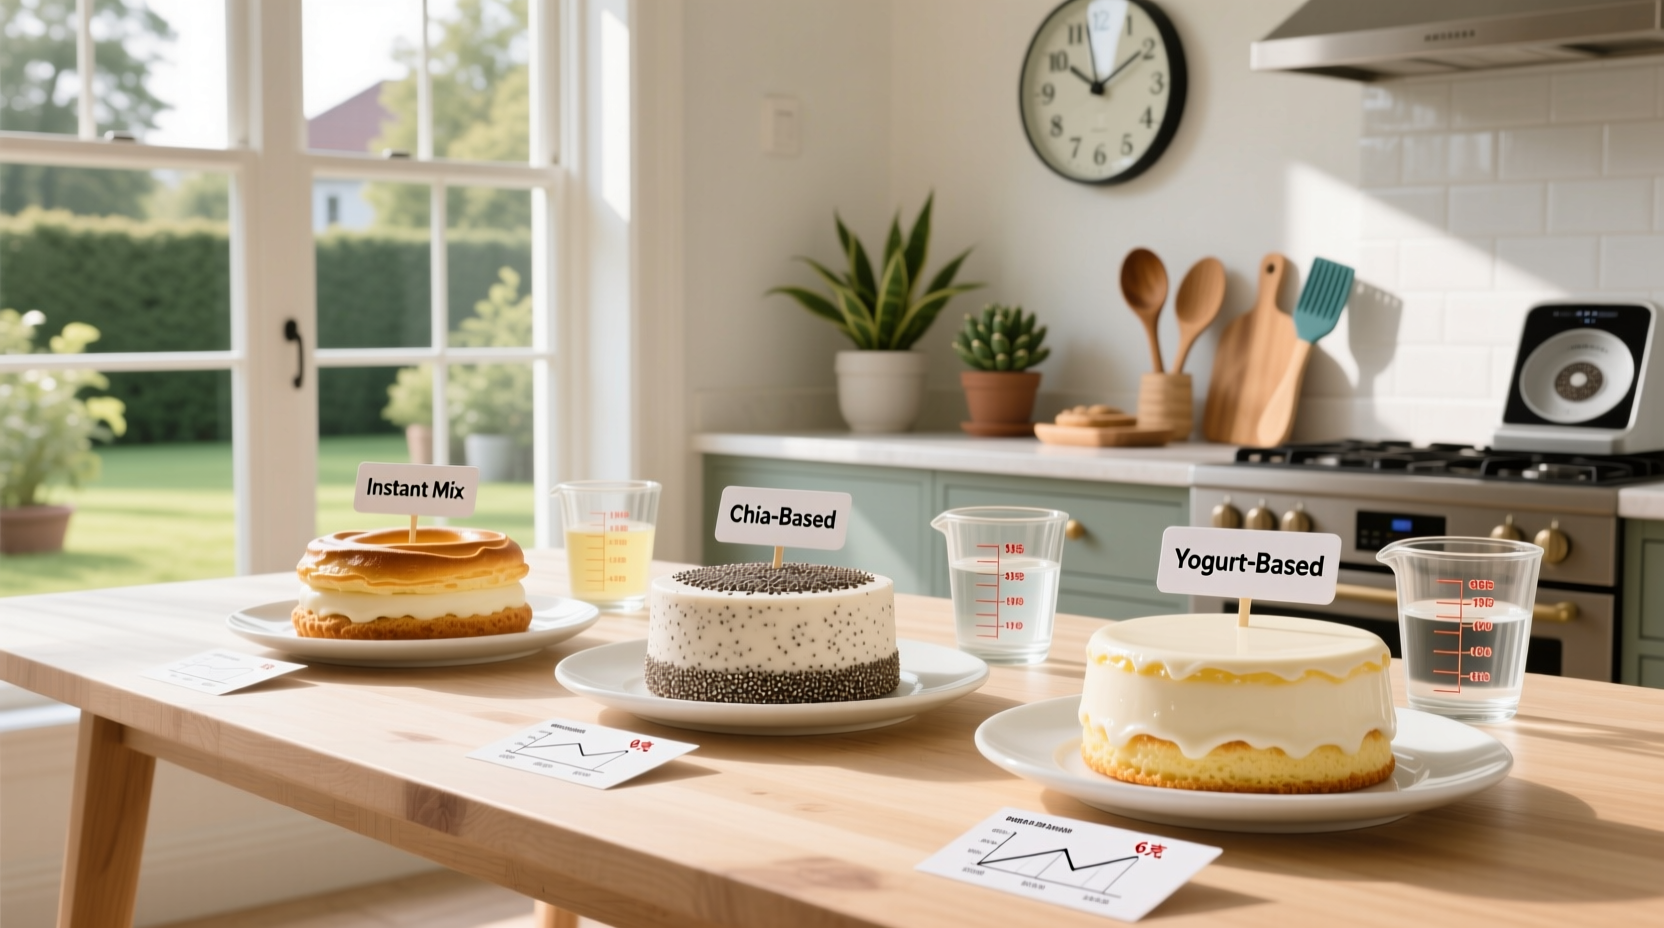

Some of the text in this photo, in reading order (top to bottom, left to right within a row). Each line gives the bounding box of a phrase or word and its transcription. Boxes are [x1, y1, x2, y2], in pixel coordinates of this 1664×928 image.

[1093, 10, 1110, 32] 12
[1068, 24, 1082, 45] 11
[1142, 38, 1156, 60] 2
[1050, 51, 1068, 72] 10
[1042, 83, 1055, 105] 9
[1150, 72, 1164, 95] 3
[1050, 115, 1063, 137] 8
[1139, 106, 1155, 129] 4
[1069, 136, 1082, 159] 7
[1093, 143, 1107, 166] 6
[1120, 133, 1133, 156] 5
[366, 477, 465, 500] Instant Mix
[730, 504, 837, 530] Chia-Based
[1174, 547, 1325, 578] Yogurt-Based
[1135, 841, 1167, 859] 6克
